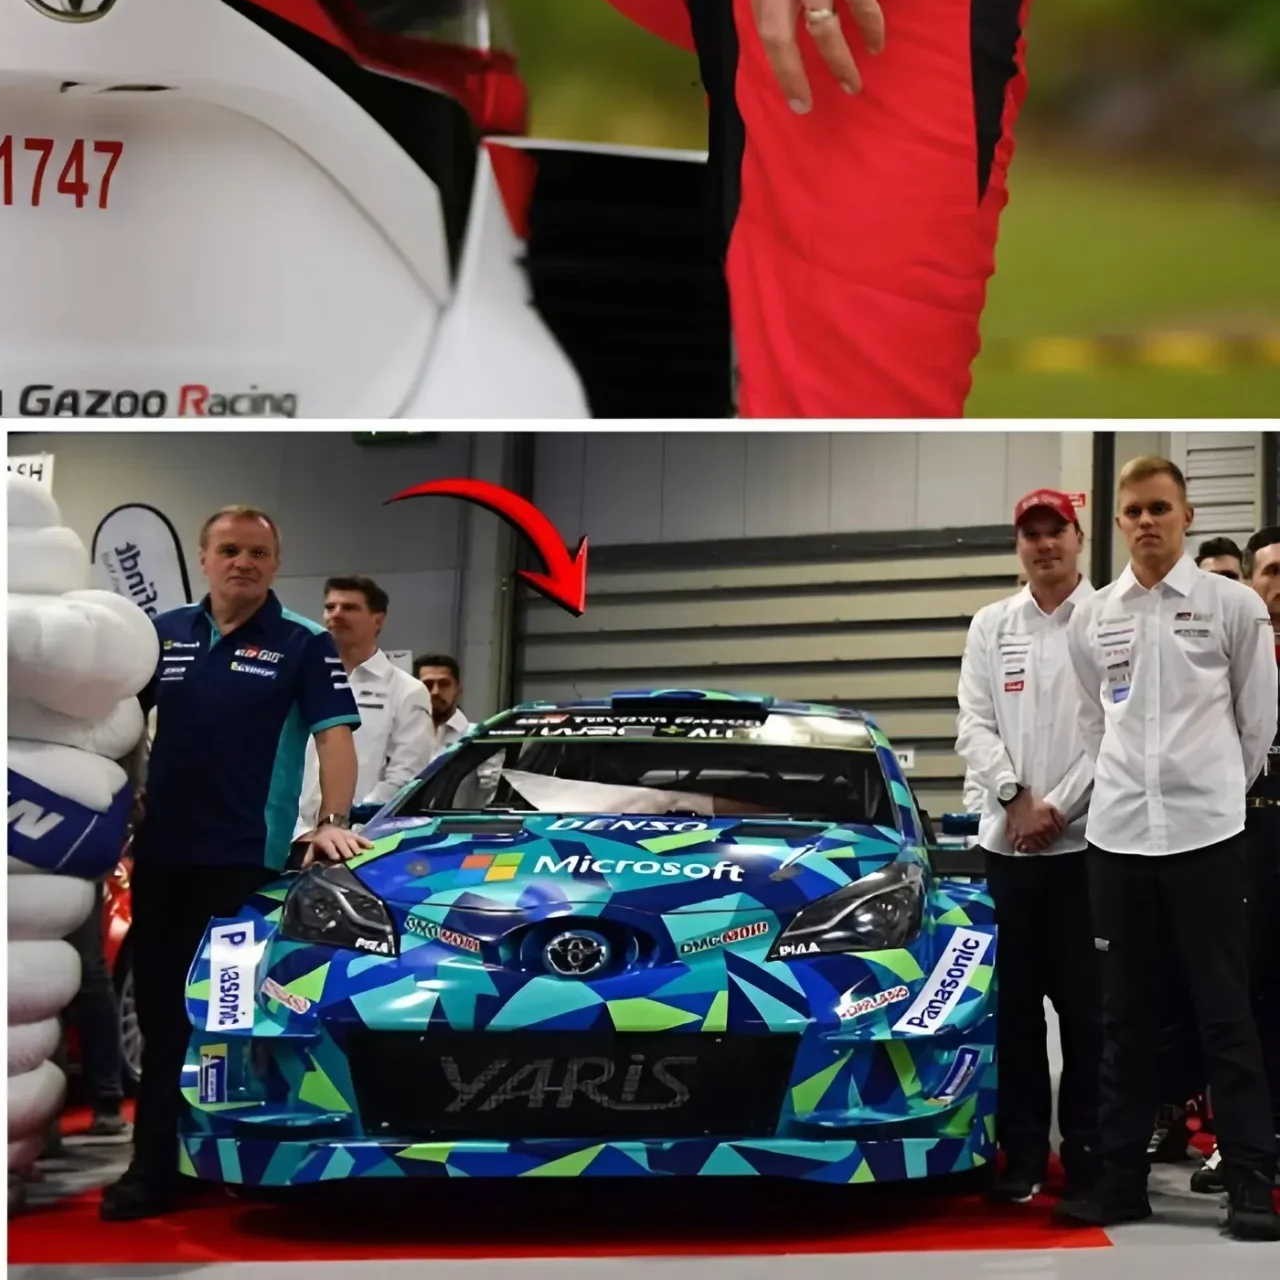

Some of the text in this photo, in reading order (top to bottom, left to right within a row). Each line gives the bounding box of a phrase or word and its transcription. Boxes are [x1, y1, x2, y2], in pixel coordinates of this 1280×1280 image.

[18, 384, 168, 419] GAZOO
[532, 854, 746, 883] Microsoft
[906, 937, 981, 1029] Panasonic
